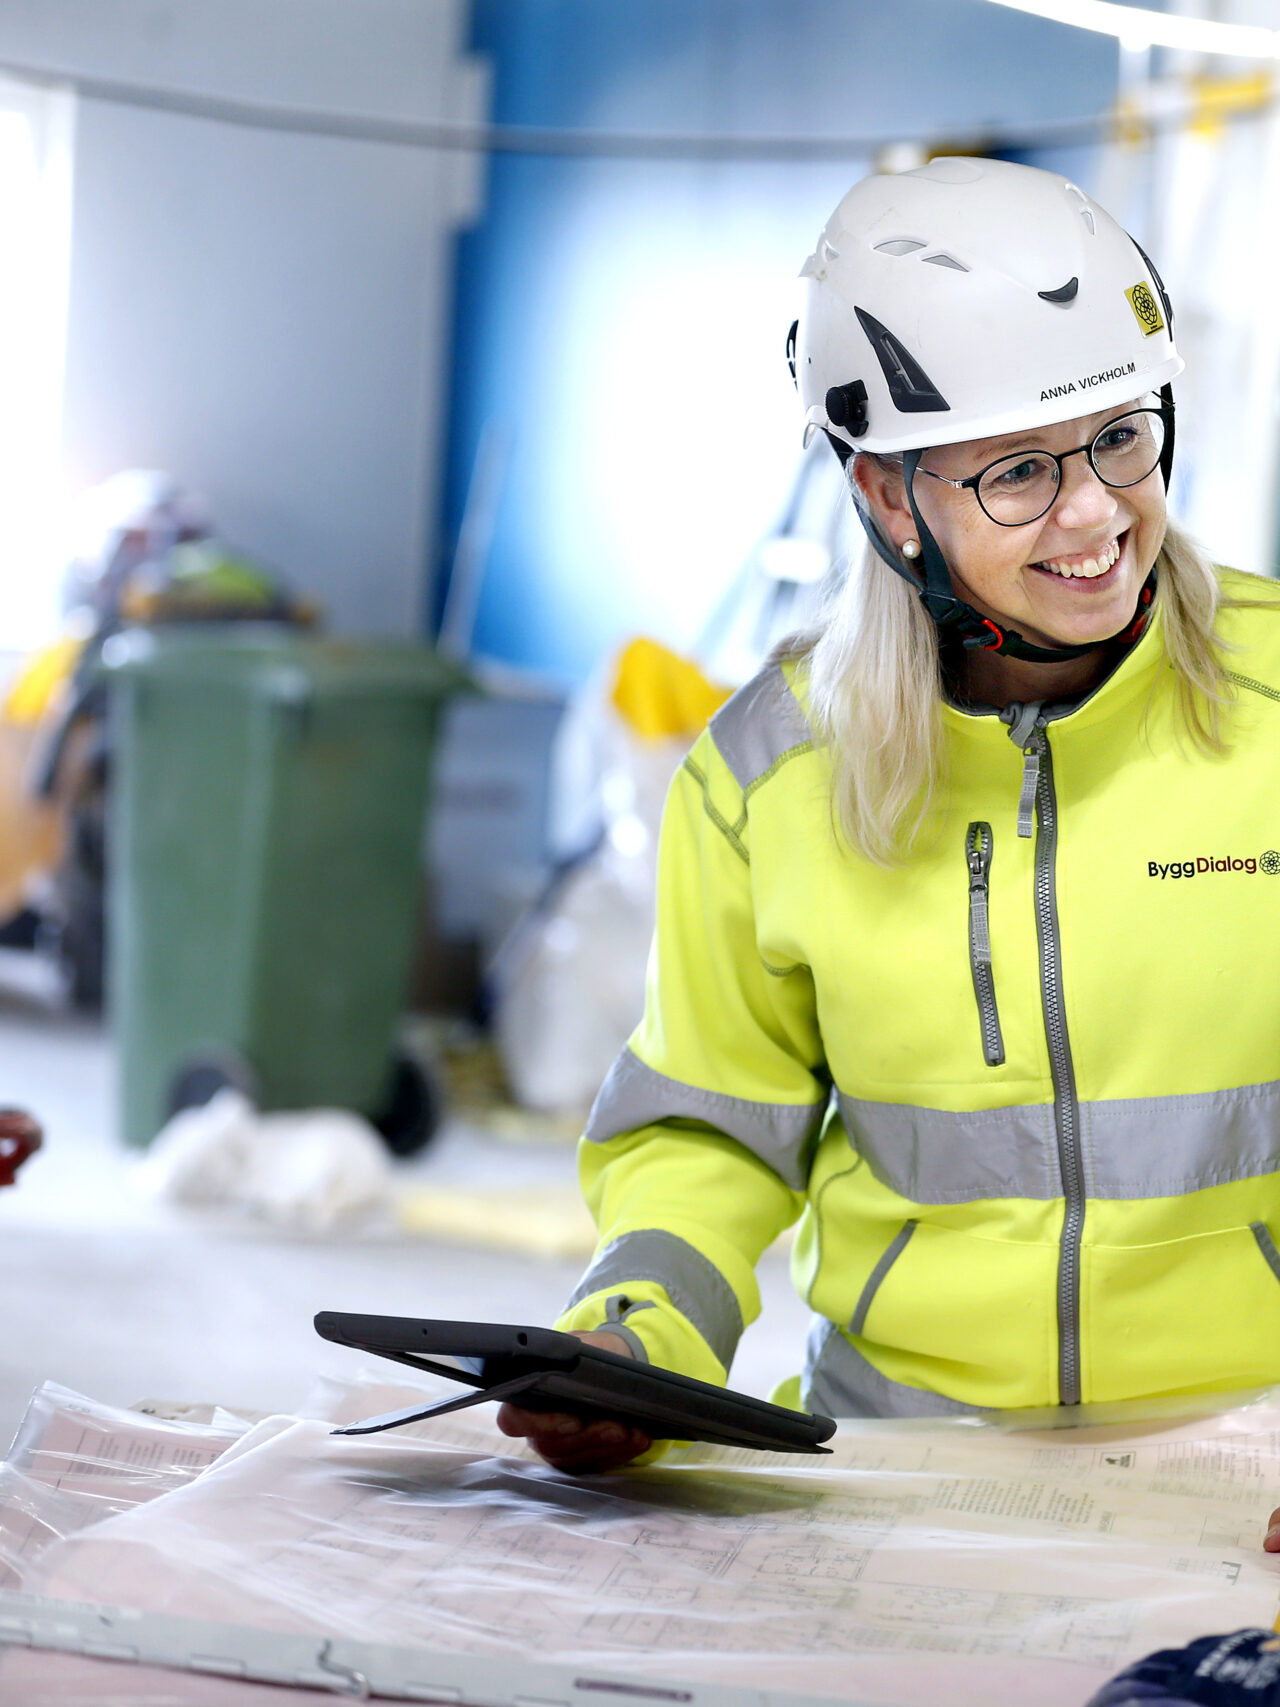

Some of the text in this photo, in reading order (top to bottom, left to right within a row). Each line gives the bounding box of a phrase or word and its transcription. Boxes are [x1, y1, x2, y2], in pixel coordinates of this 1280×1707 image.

[1040, 362, 1136, 402] ANNA VICKHOLM
[1148, 856, 1257, 880] ByggDialog
